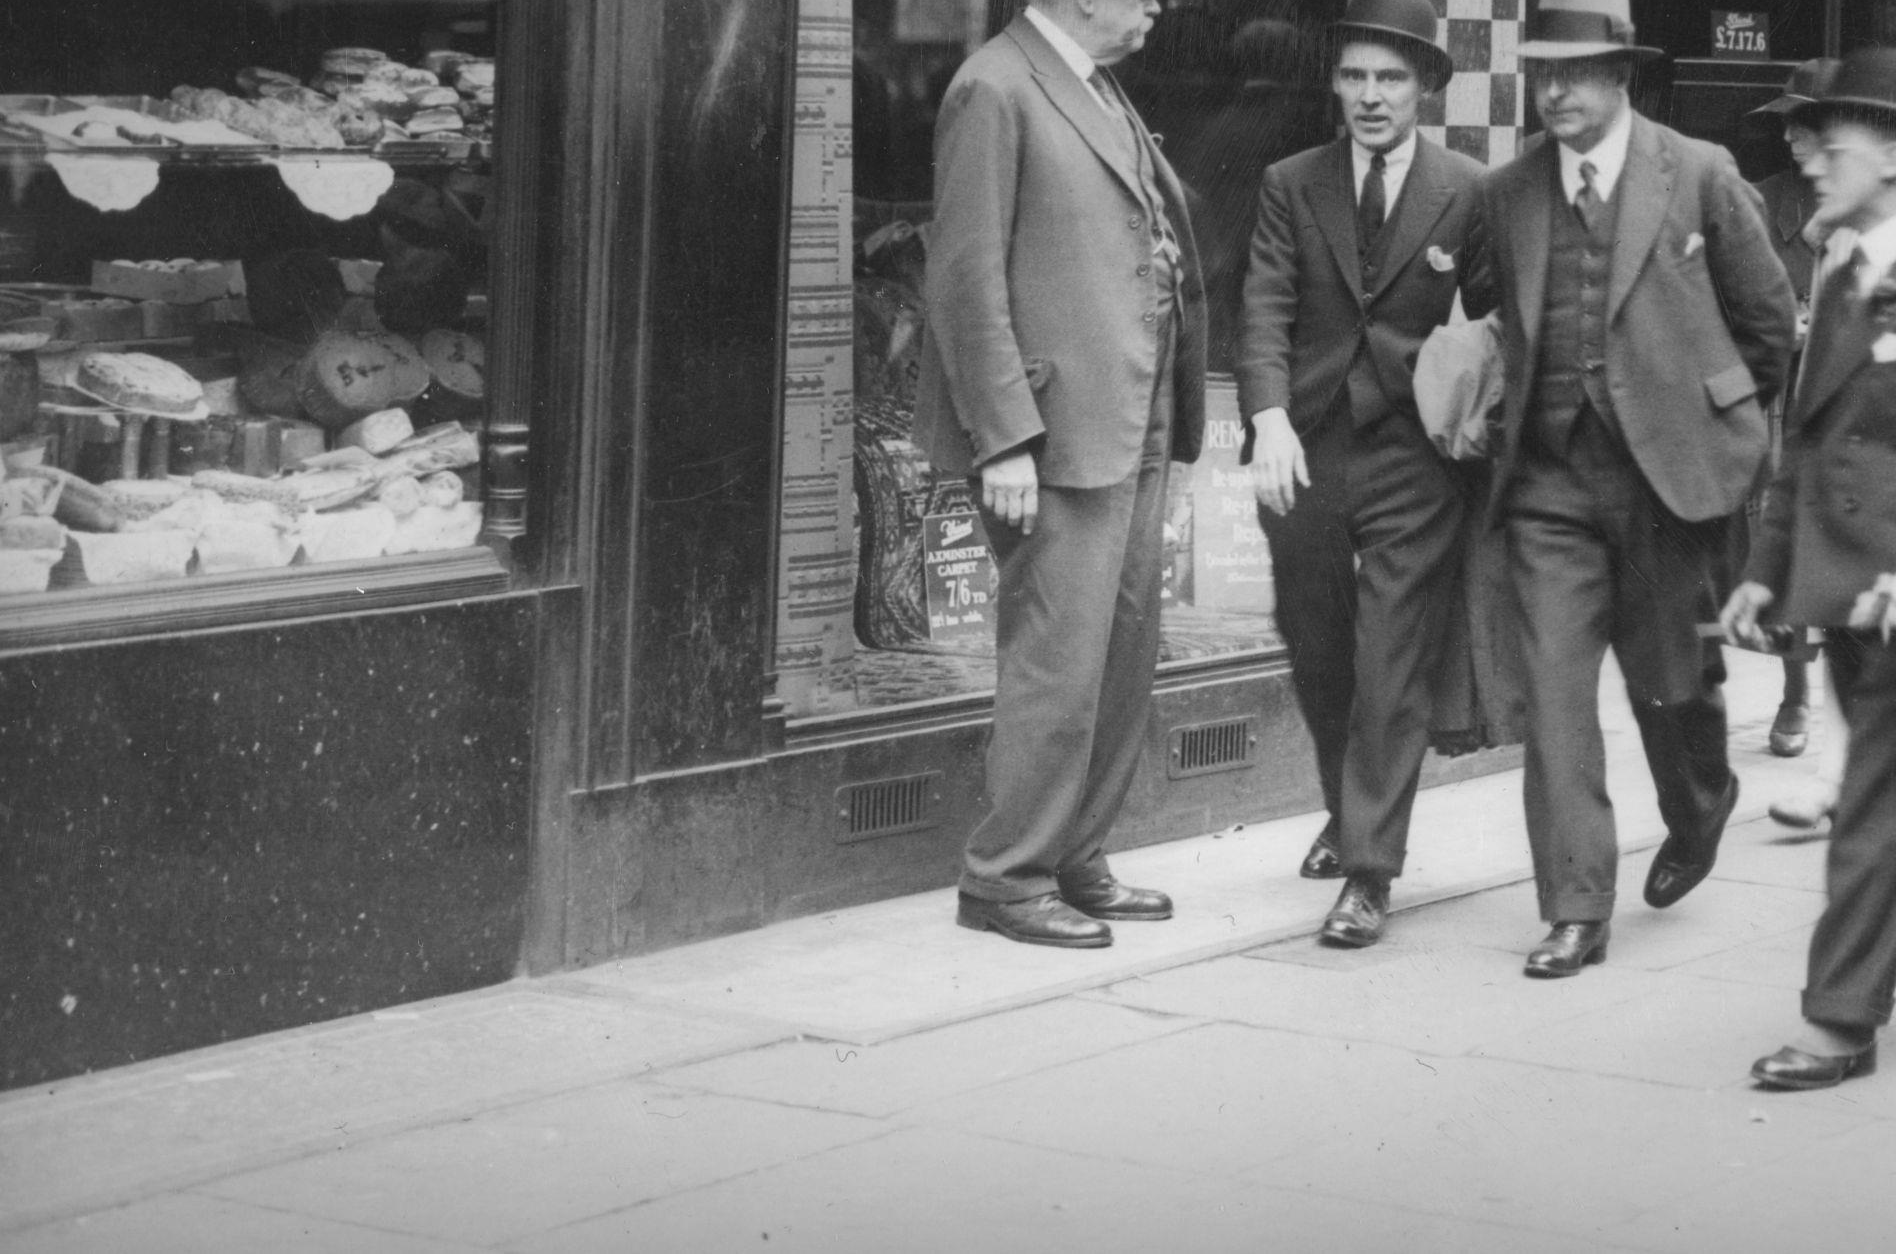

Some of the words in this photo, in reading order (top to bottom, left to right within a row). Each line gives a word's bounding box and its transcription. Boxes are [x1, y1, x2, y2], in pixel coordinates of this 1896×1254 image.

[1207, 419, 1247, 448] REN
[926, 546, 986, 564] AXMINSTER
[937, 560, 978, 577] CARPET
